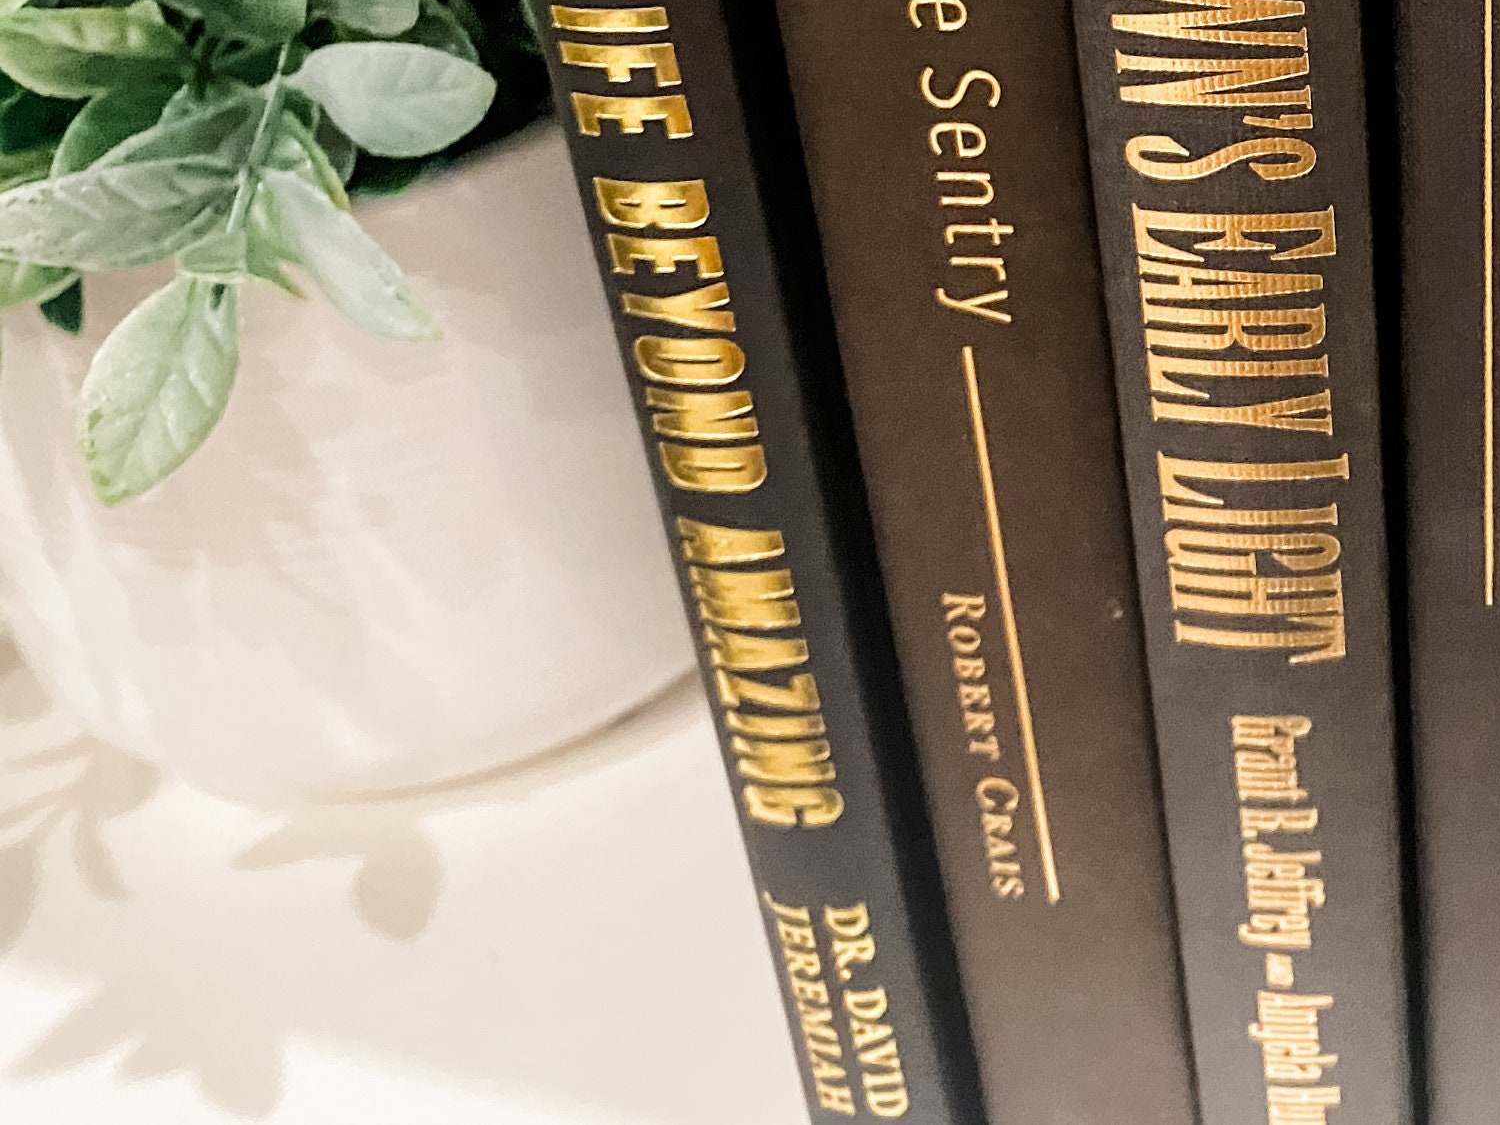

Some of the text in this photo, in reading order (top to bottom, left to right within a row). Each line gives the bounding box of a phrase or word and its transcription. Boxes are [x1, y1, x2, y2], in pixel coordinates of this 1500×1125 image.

[920, 66, 1014, 322] Sentry
[593, 177, 767, 493] BEYOND
[1131, 202, 1337, 437] EARLY
[1157, 450, 1350, 665] LIGHT
[676, 516, 845, 828] AMAZING
[941, 591, 1025, 899] ROBERT CRAIS
[1231, 714, 1312, 801] Grant
[1237, 842, 1325, 949] Jeffrey
[1239, 807, 1318, 838] R.
[763, 890, 856, 1117] JEREMIAH
[823, 902, 909, 1119] DR. DAVID
[1247, 989, 1334, 1082] Angela
